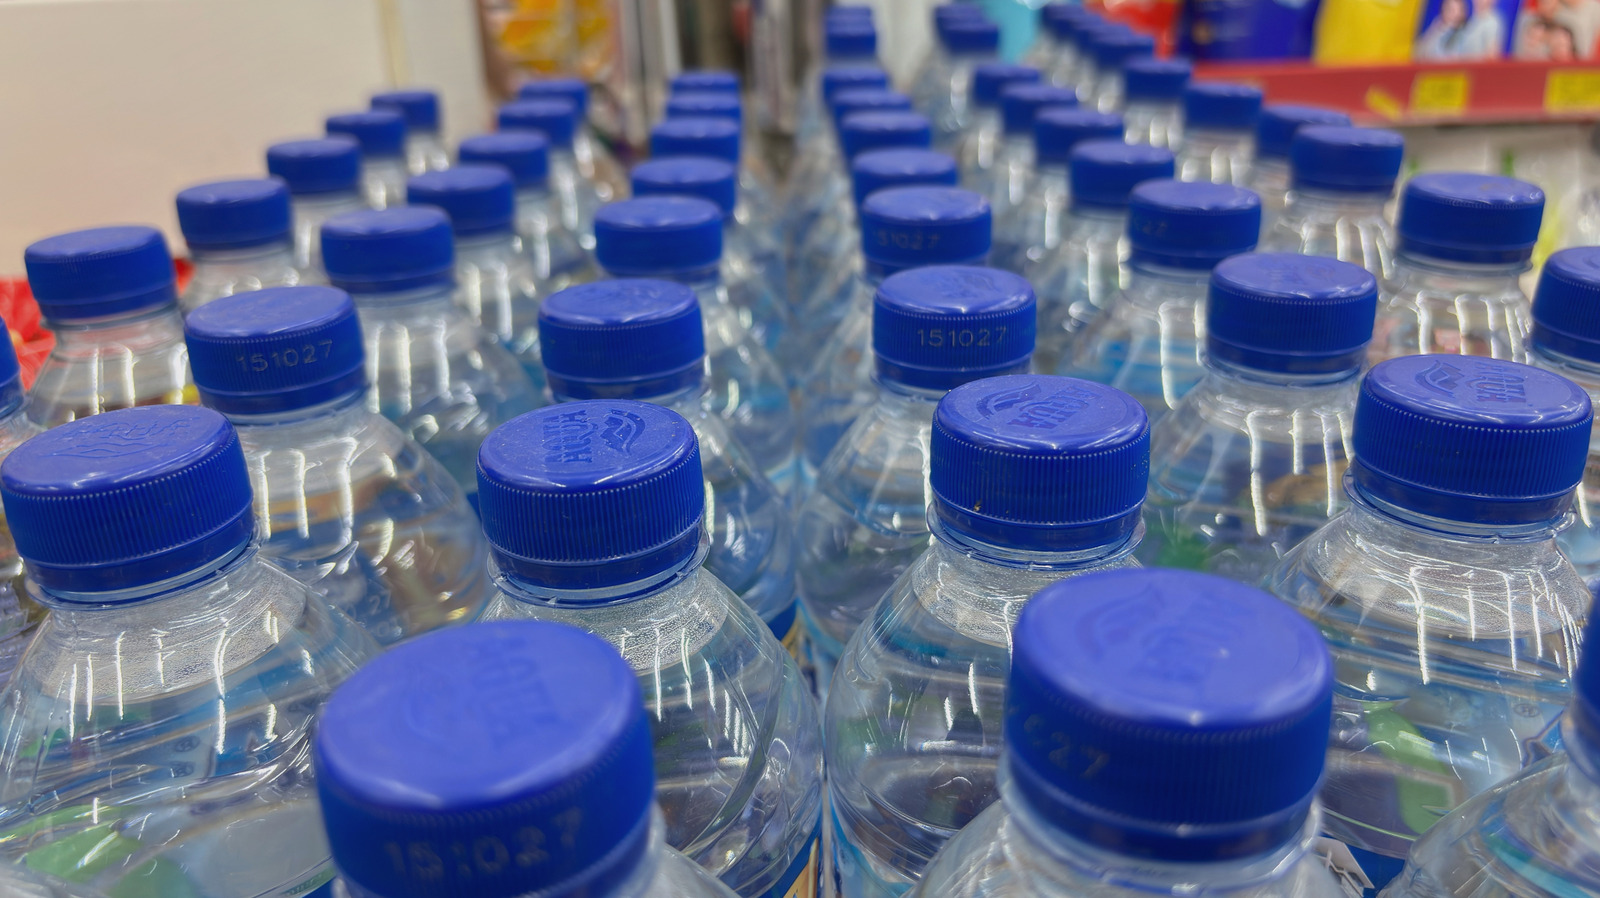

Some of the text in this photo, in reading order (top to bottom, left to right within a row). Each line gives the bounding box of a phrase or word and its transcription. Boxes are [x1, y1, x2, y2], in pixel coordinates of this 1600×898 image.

[917, 326, 1007, 347] 151027
[236, 340, 332, 372] 151027
[542, 410, 598, 462] AQUA
